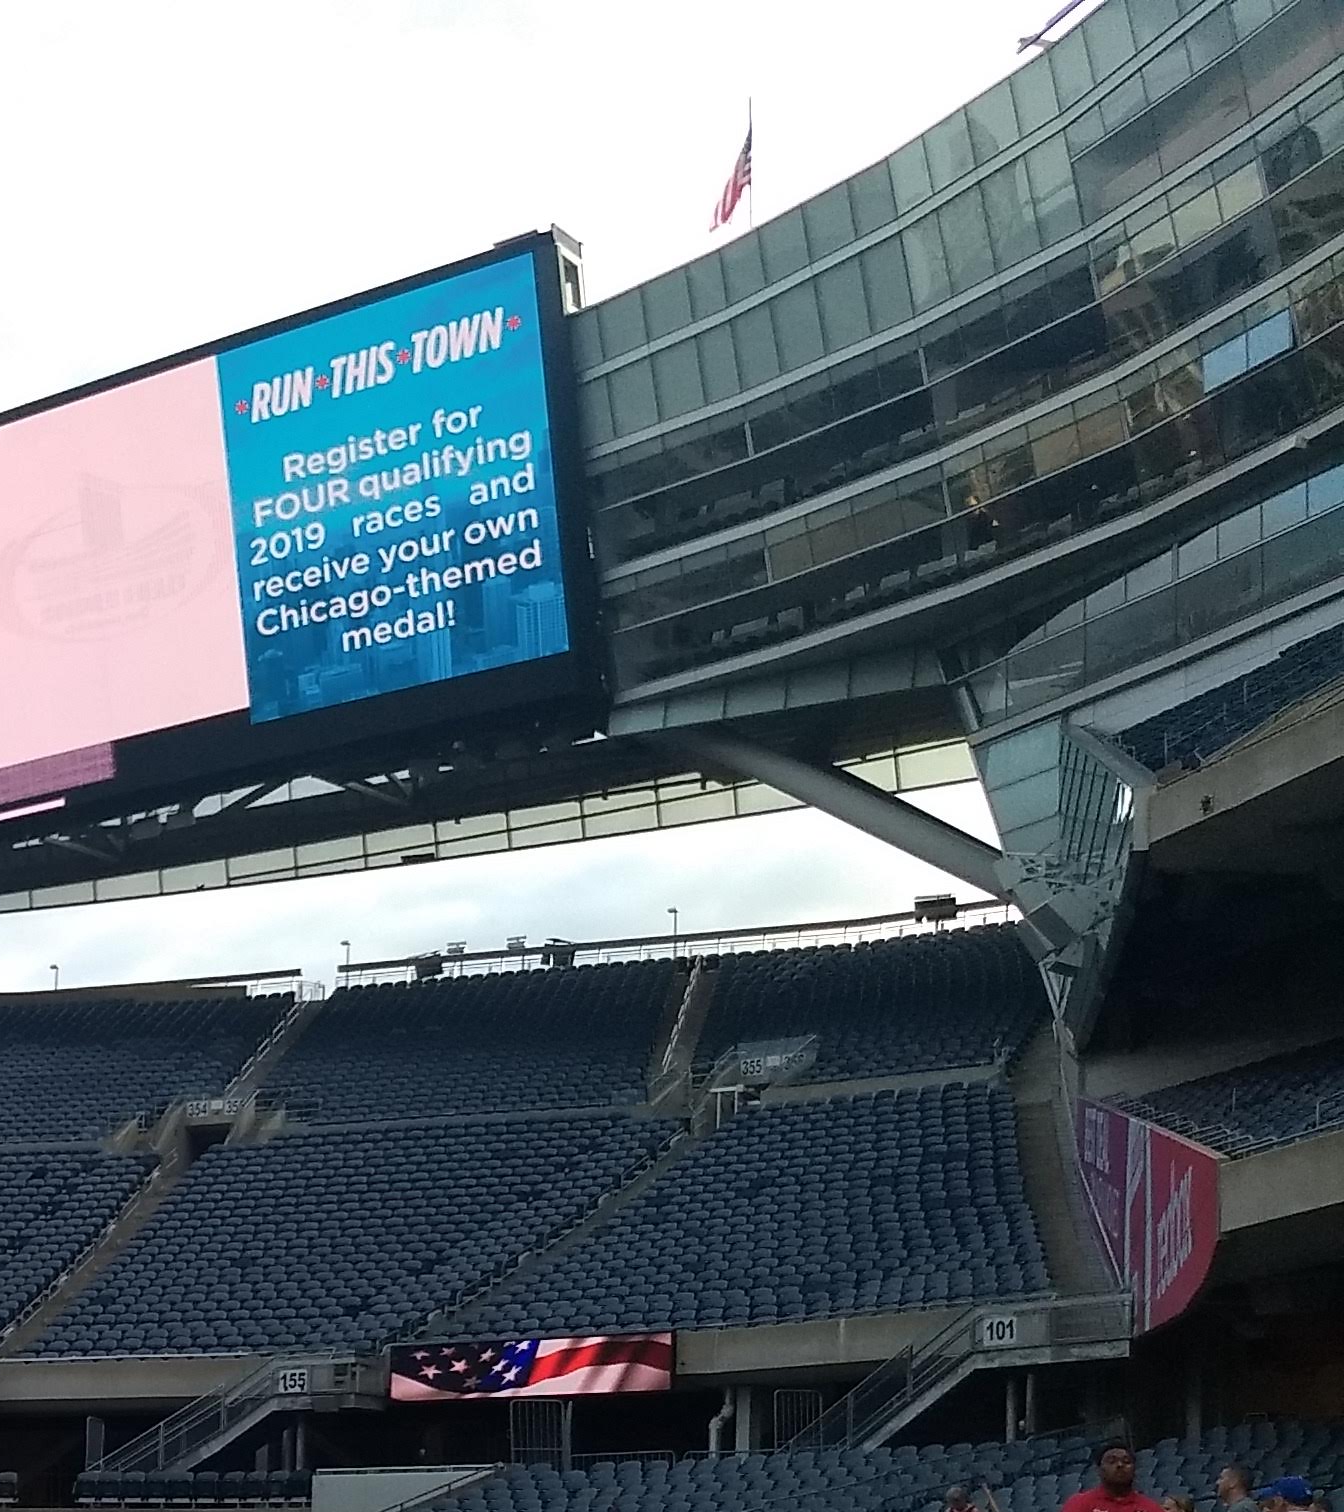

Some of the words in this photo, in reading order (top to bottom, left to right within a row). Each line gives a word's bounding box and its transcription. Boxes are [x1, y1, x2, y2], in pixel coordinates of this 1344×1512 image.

[250, 366, 313, 424] RUN
[329, 341, 396, 399] THIS
[411, 307, 505, 375] TOWN
[253, 478, 349, 528] FOUR
[358, 430, 532, 500] qualifying
[282, 422, 422, 484] Register
[432, 404, 483, 439] for
[250, 522, 326, 566] 2019
[352, 494, 441, 538] races
[469, 463, 536, 506] and
[253, 552, 371, 602] receive
[377, 528, 455, 574] your
[464, 508, 540, 546] own
[255, 540, 542, 637] Chicago-themed
[342, 601, 457, 652] medal!
[742, 1059, 762, 1076] 355
[986, 1319, 1015, 1341] 101
[280, 1372, 306, 1391] 155
